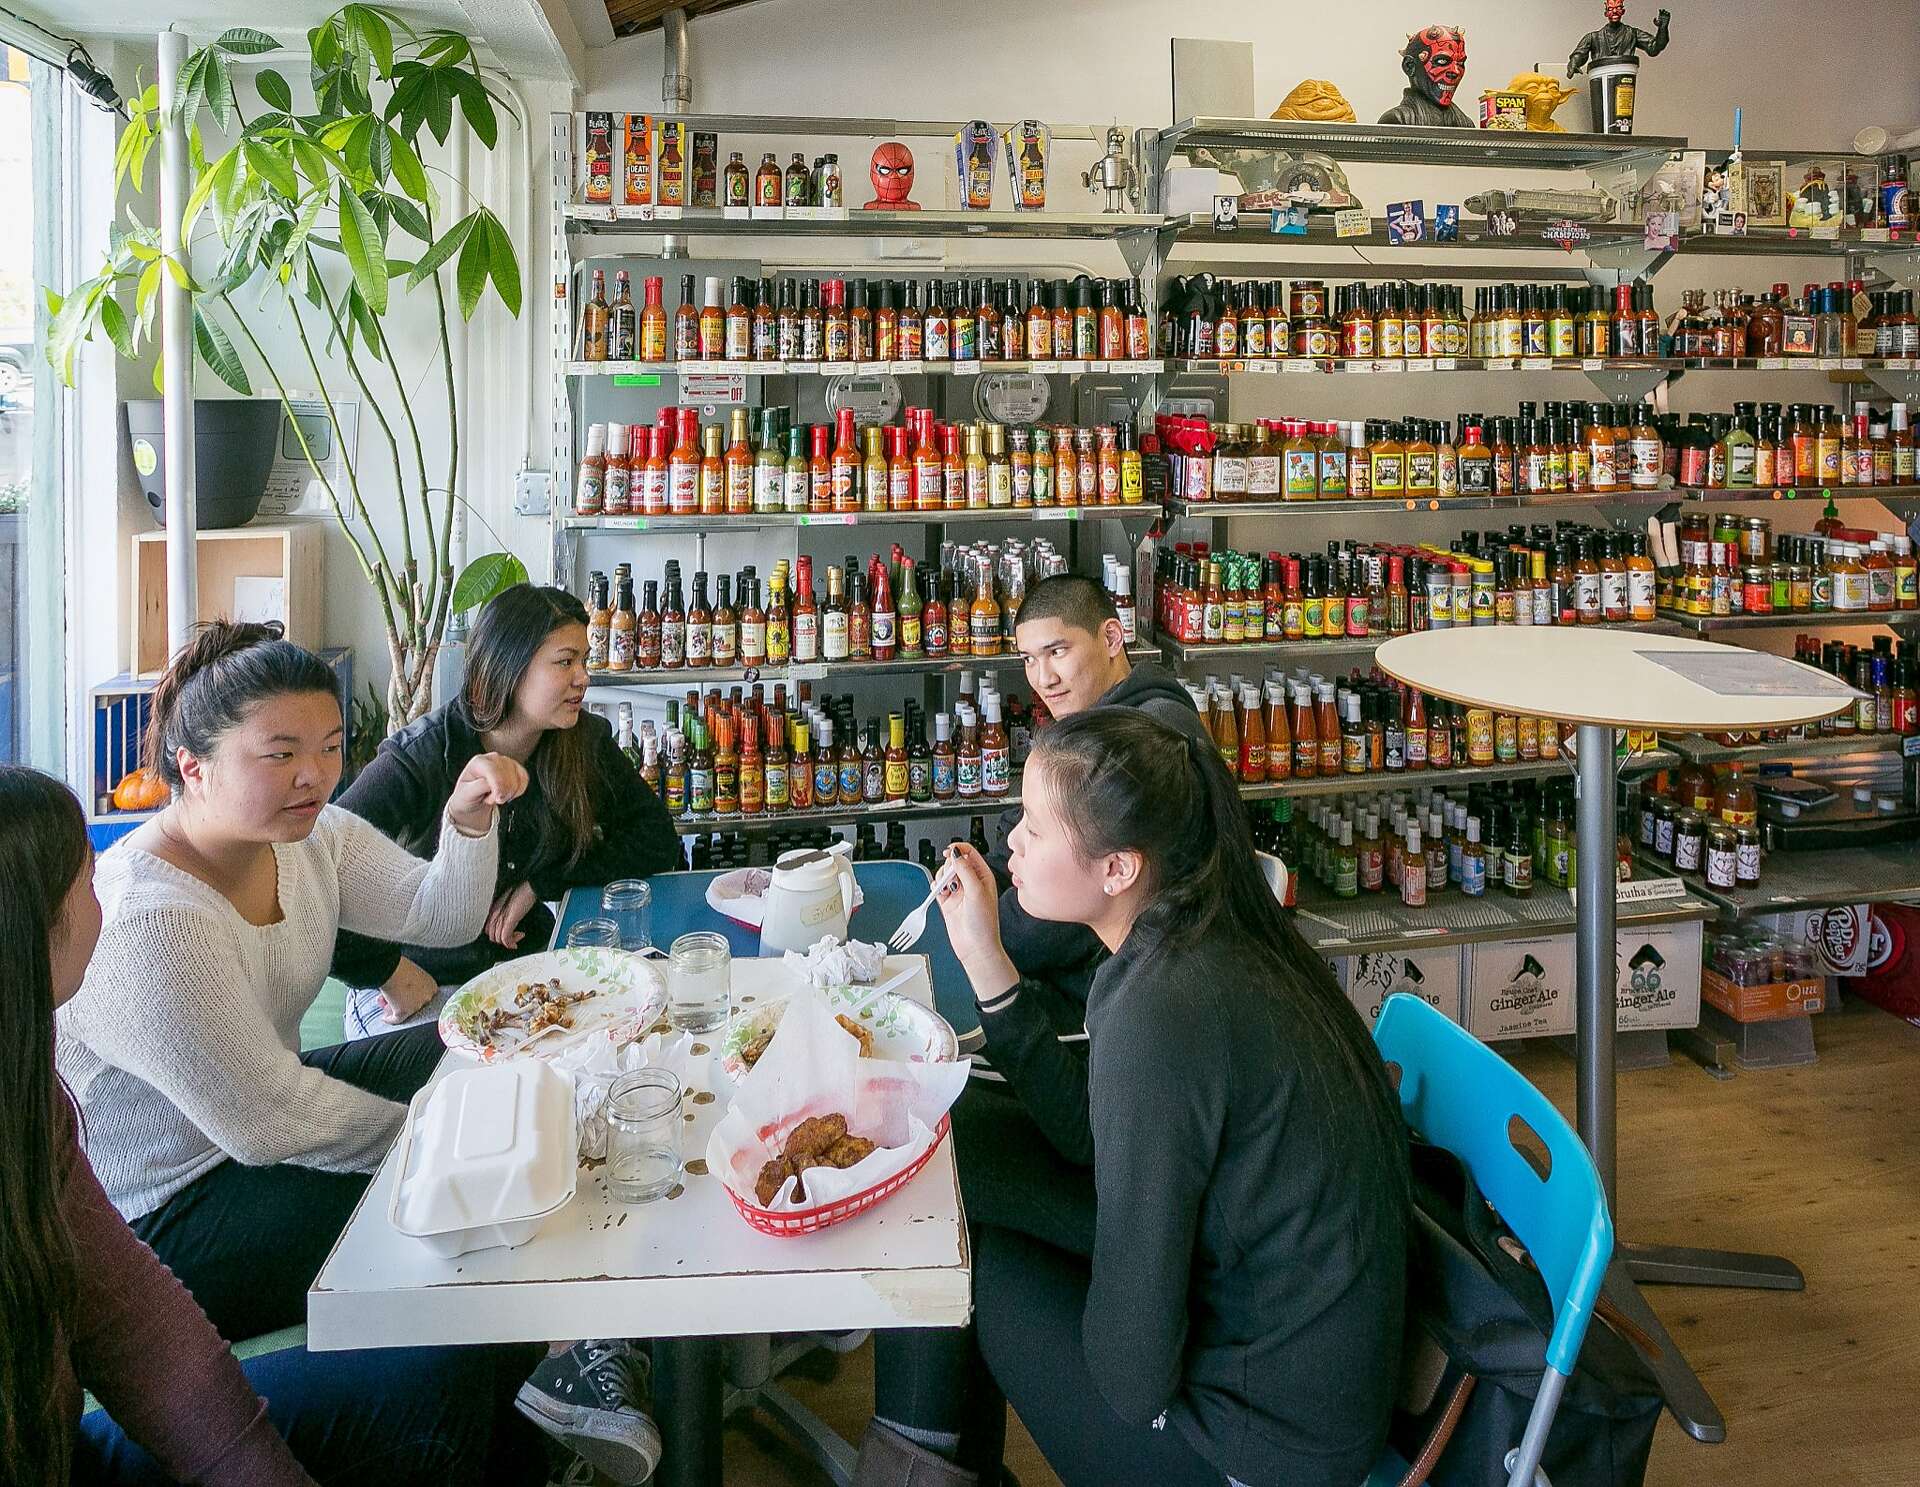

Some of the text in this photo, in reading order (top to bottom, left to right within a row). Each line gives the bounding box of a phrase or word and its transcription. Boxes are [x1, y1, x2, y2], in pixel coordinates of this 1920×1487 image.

[1496, 97, 1526, 108] SPAM
[630, 165, 650, 174] DEATH
[731, 387, 743, 401] OFF
[1631, 966, 1661, 992] 66
[1490, 989, 1558, 1011] Ginger Ale
[1656, 989, 1676, 1003] Ale
[1499, 1021, 1531, 1033] Jasmine
[1533, 1018, 1548, 1026] Tea
